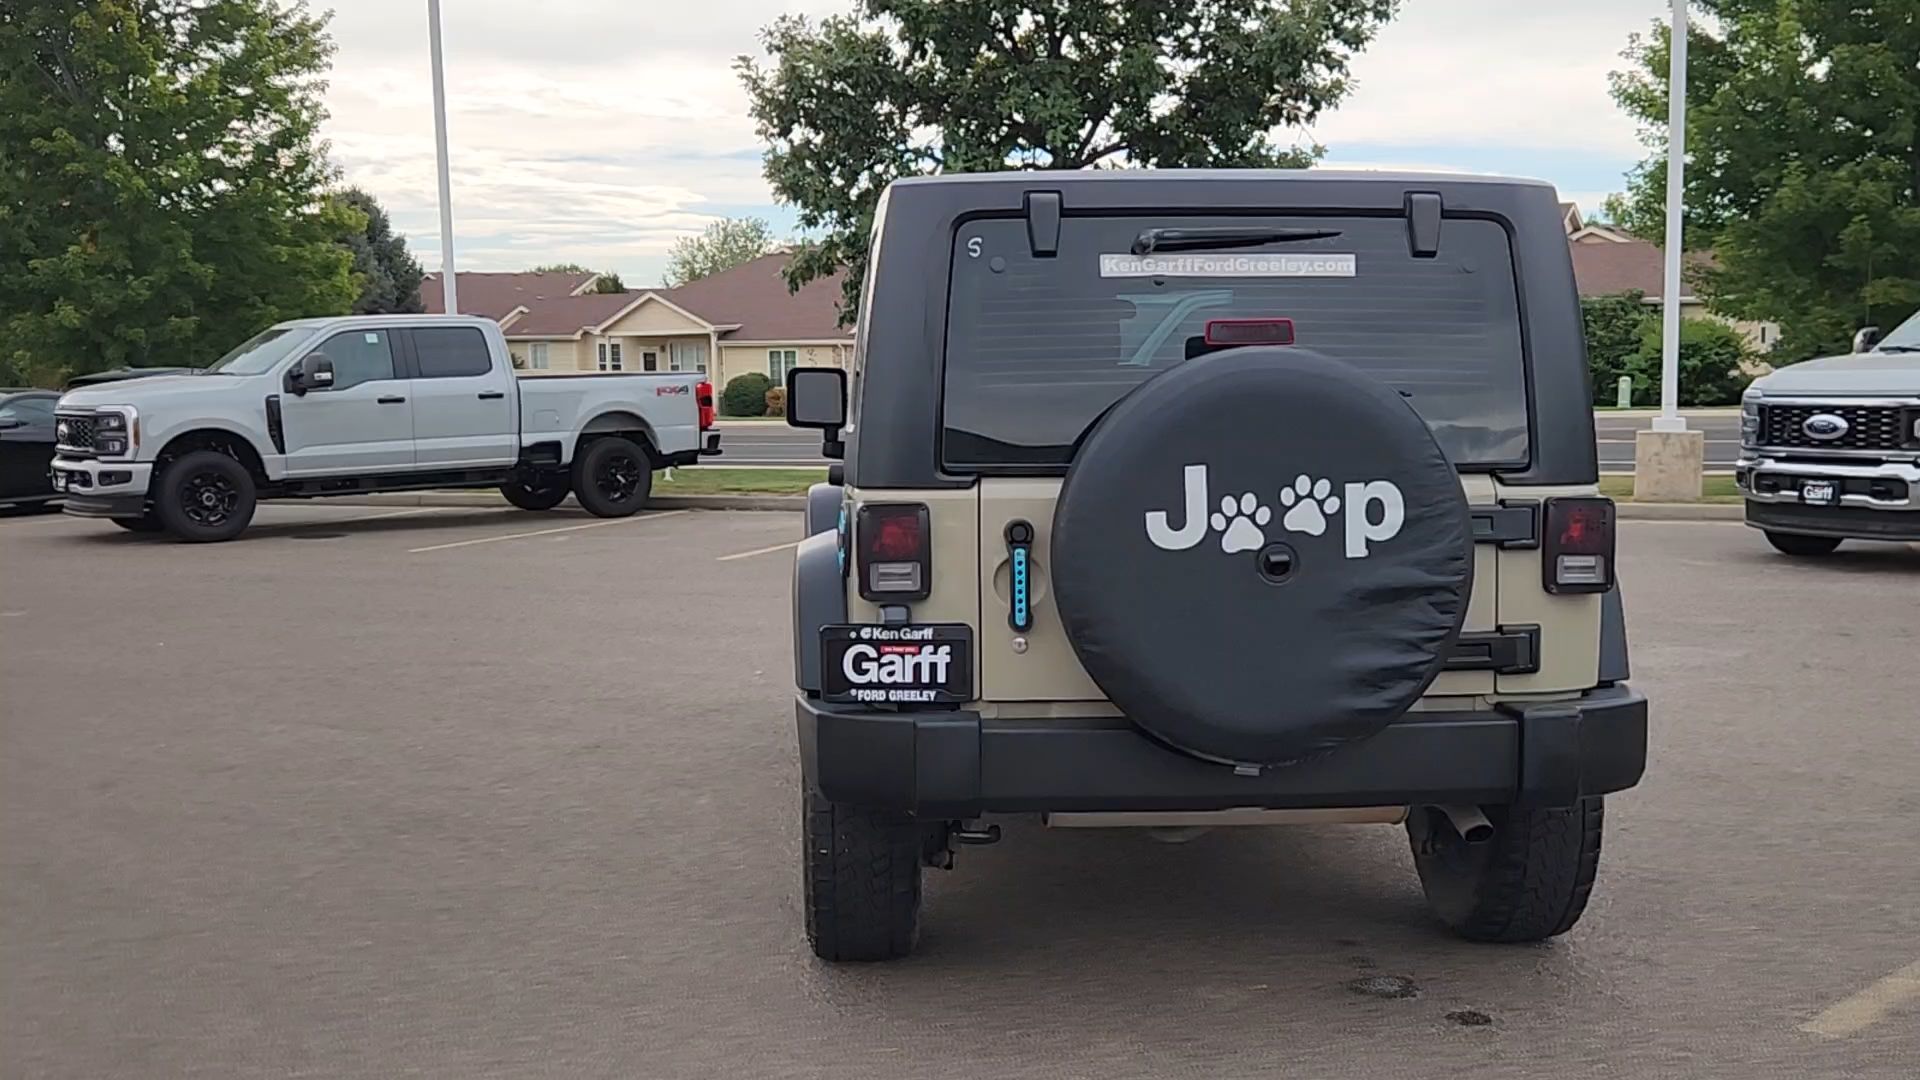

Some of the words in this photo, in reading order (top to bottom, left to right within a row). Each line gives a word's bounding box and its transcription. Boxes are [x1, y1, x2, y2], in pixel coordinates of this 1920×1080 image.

[1104, 258, 1354, 274] KenGarffFordGreeley.com
[872, 628, 899, 640] Ken
[900, 628, 934, 640] Garff
[842, 644, 951, 683] Garff
[857, 690, 887, 701] FORD
[888, 690, 937, 701] GREELEY
